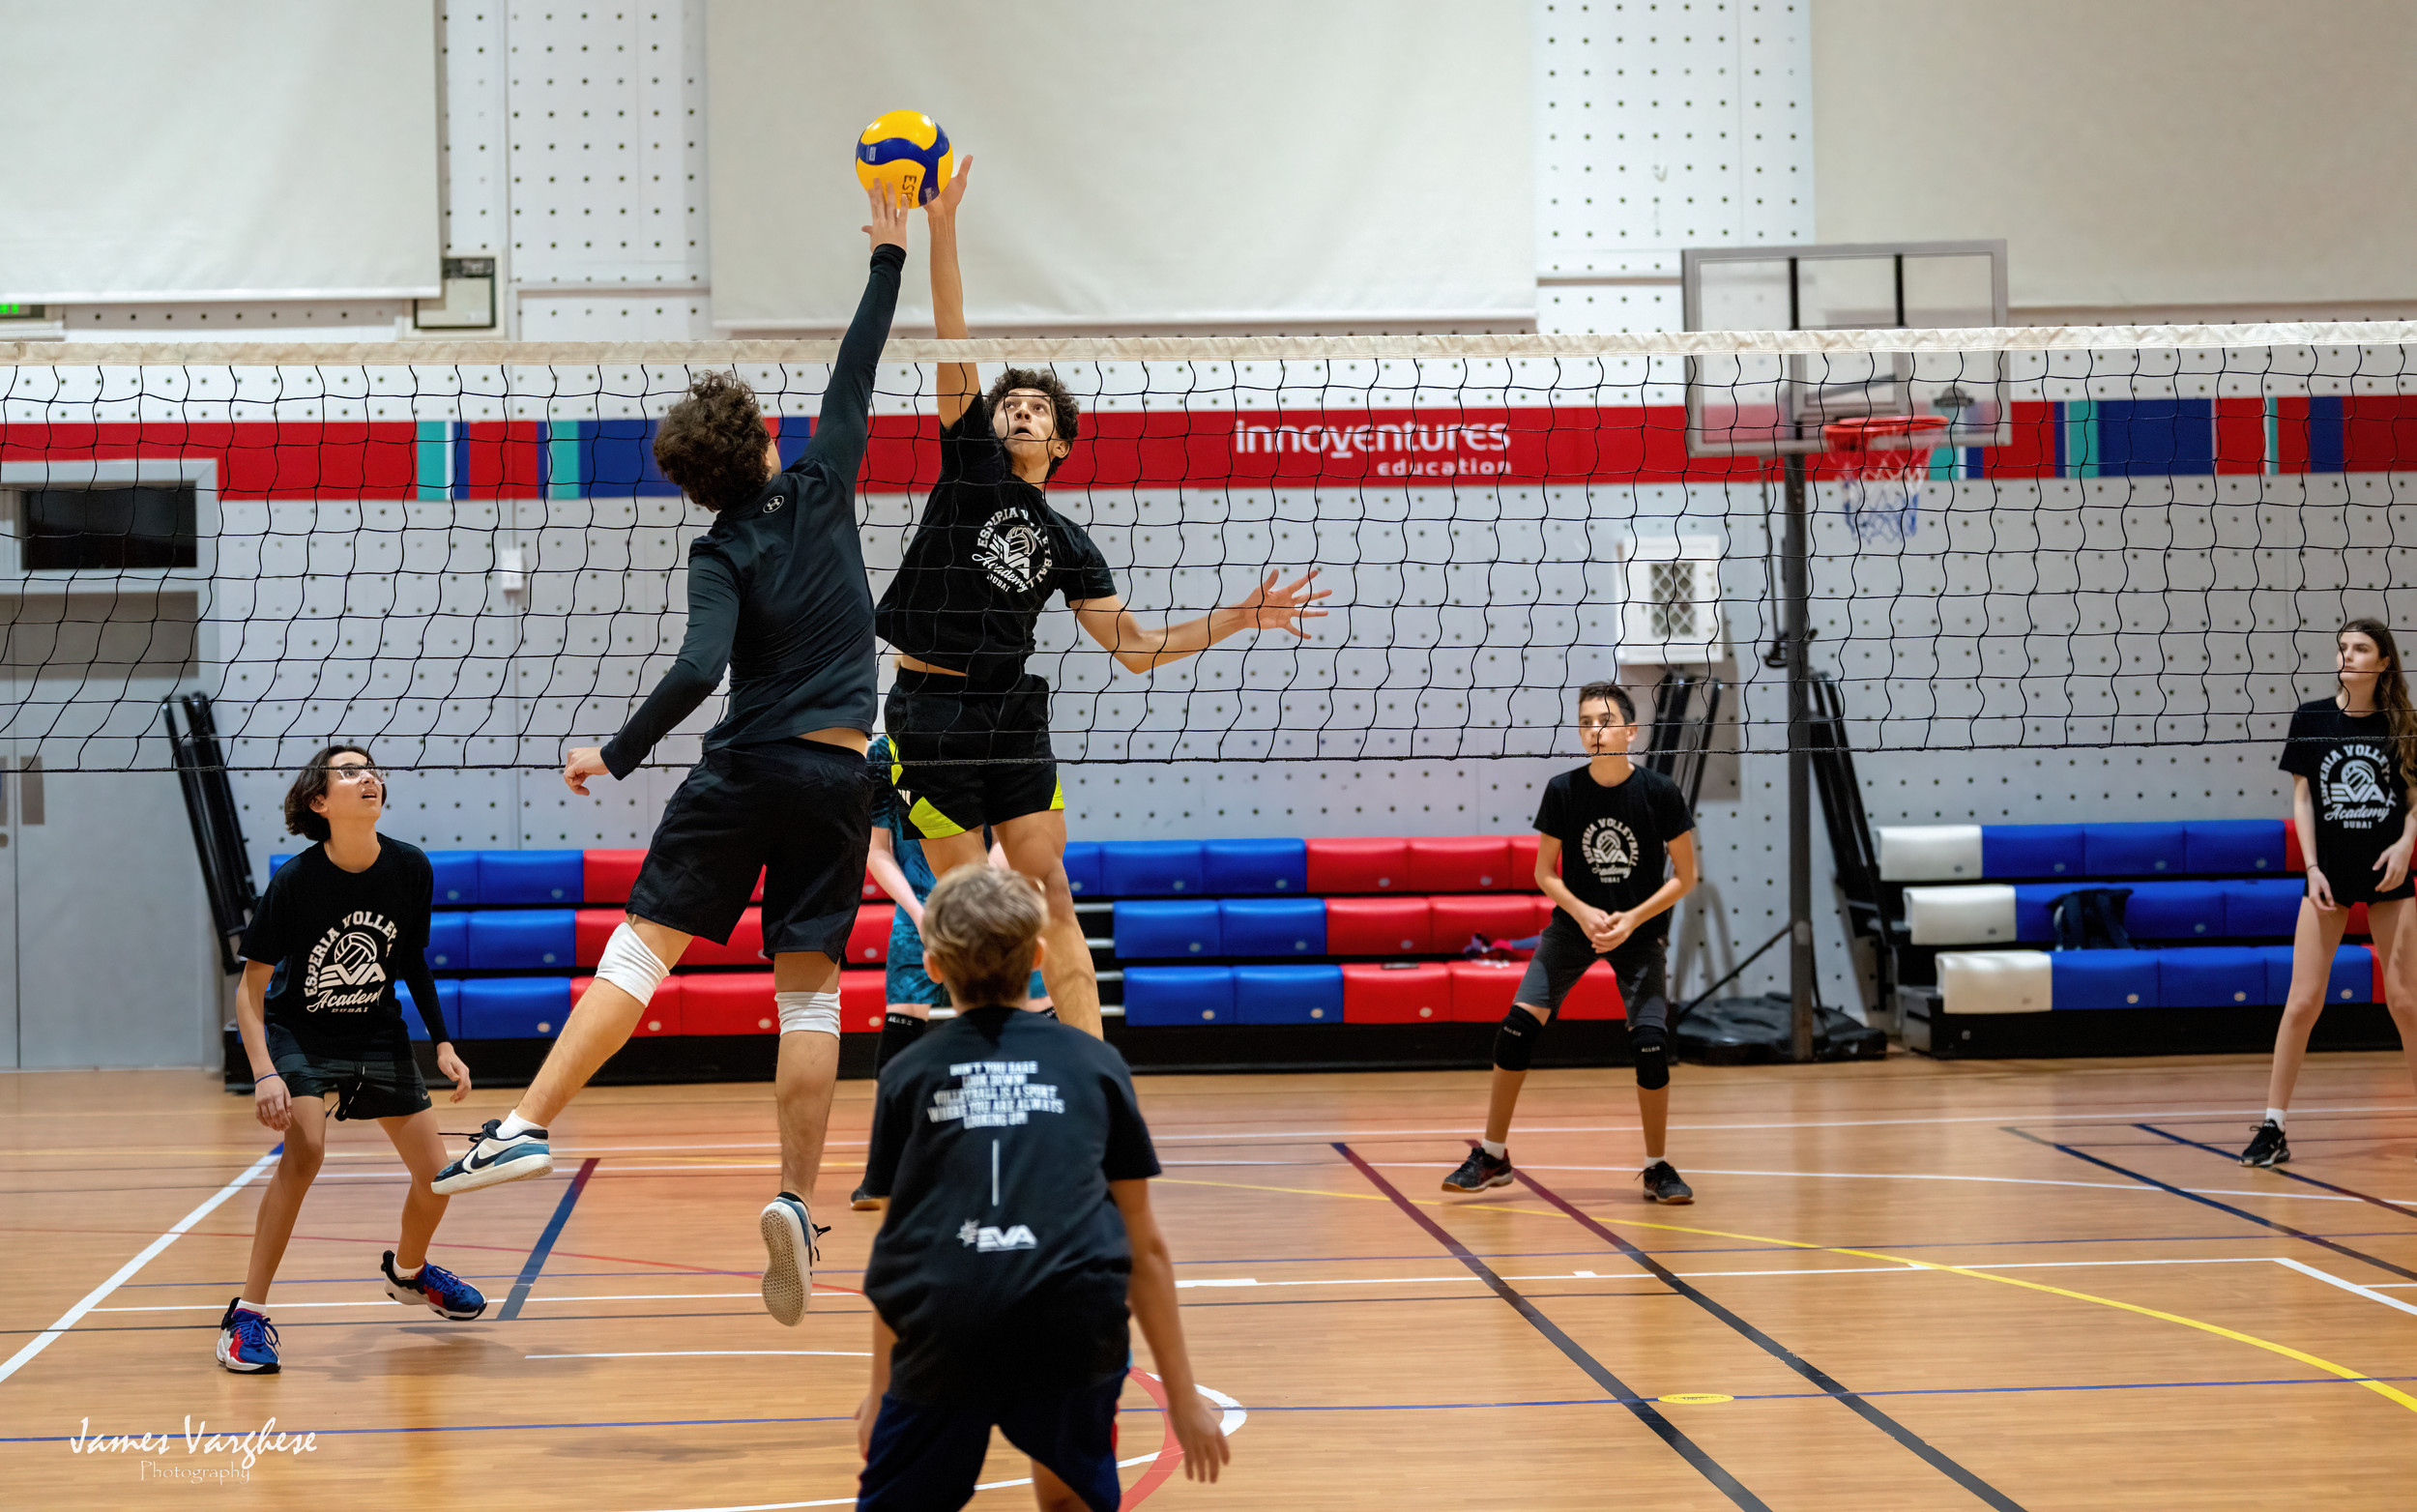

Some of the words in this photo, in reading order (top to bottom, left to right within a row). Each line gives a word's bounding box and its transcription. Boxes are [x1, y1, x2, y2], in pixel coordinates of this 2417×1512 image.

[901, 175, 917, 202] ESP
[1236, 420, 1511, 458] innoventures
[1377, 458, 1512, 477] education
[2323, 803, 2390, 823] Academy
[304, 927, 340, 998] ESPERIA
